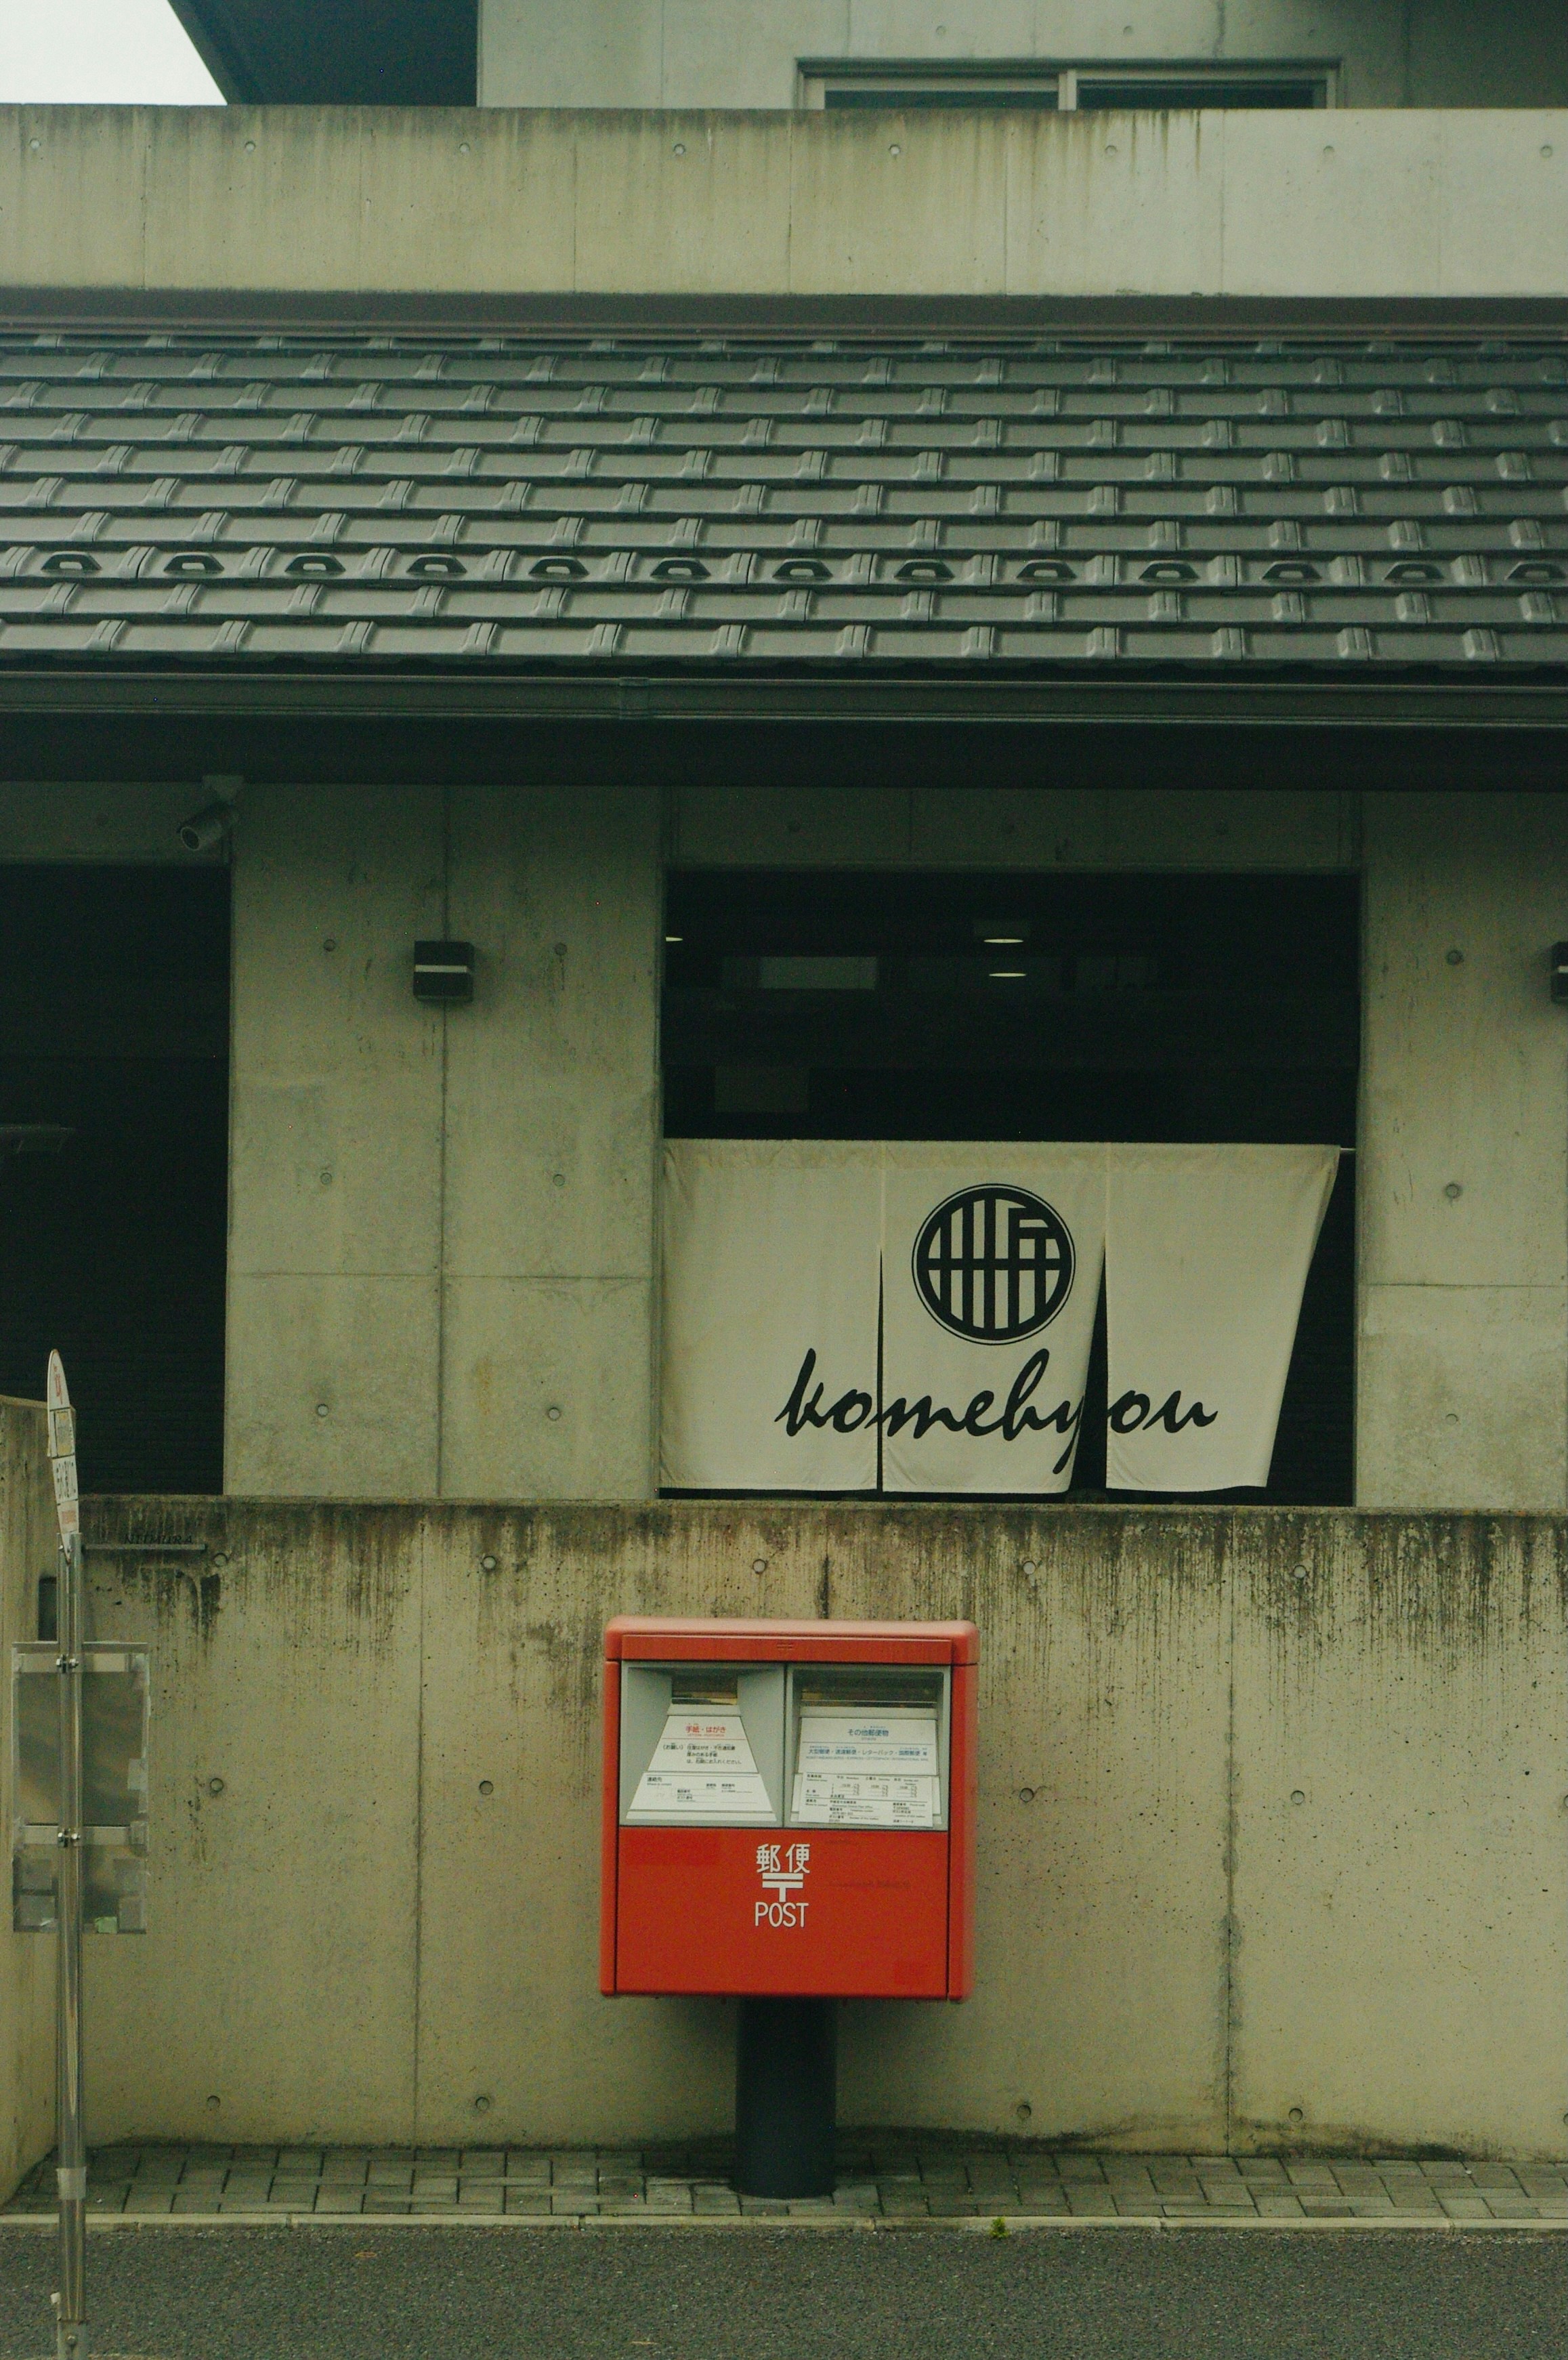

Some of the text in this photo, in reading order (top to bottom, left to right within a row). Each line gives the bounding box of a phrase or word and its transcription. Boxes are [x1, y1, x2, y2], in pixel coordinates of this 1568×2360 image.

[775, 1348, 1219, 1475] komehyou
[685, 1725, 726, 1733] 手紙・はがき
[848, 1729, 889, 1737] その他郵便物
[756, 1843, 810, 1874] 郵便
[755, 1902, 809, 1928] POST
